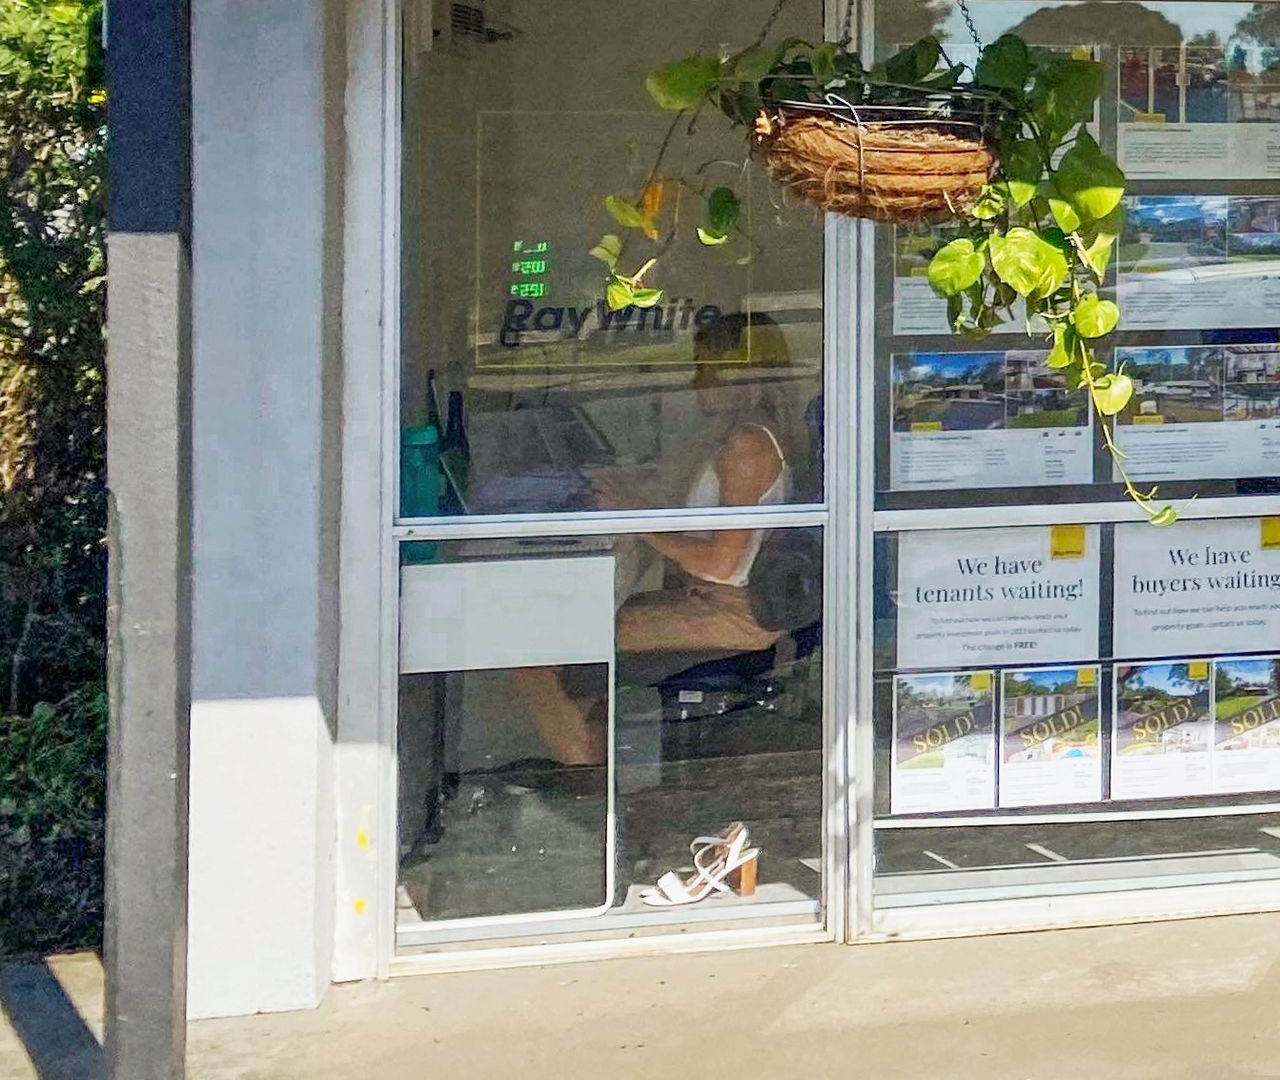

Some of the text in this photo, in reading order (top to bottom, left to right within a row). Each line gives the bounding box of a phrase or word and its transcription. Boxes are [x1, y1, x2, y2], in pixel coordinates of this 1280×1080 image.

[957, 556, 1043, 576] We have
[1168, 546, 1252, 566] We have
[916, 579, 1084, 604] tenants waiting!
[1132, 575, 1201, 596] buyers
[912, 711, 979, 753] SOLD!
[1020, 705, 1085, 748] SOLD!
[1132, 698, 1197, 741] SOLD!
